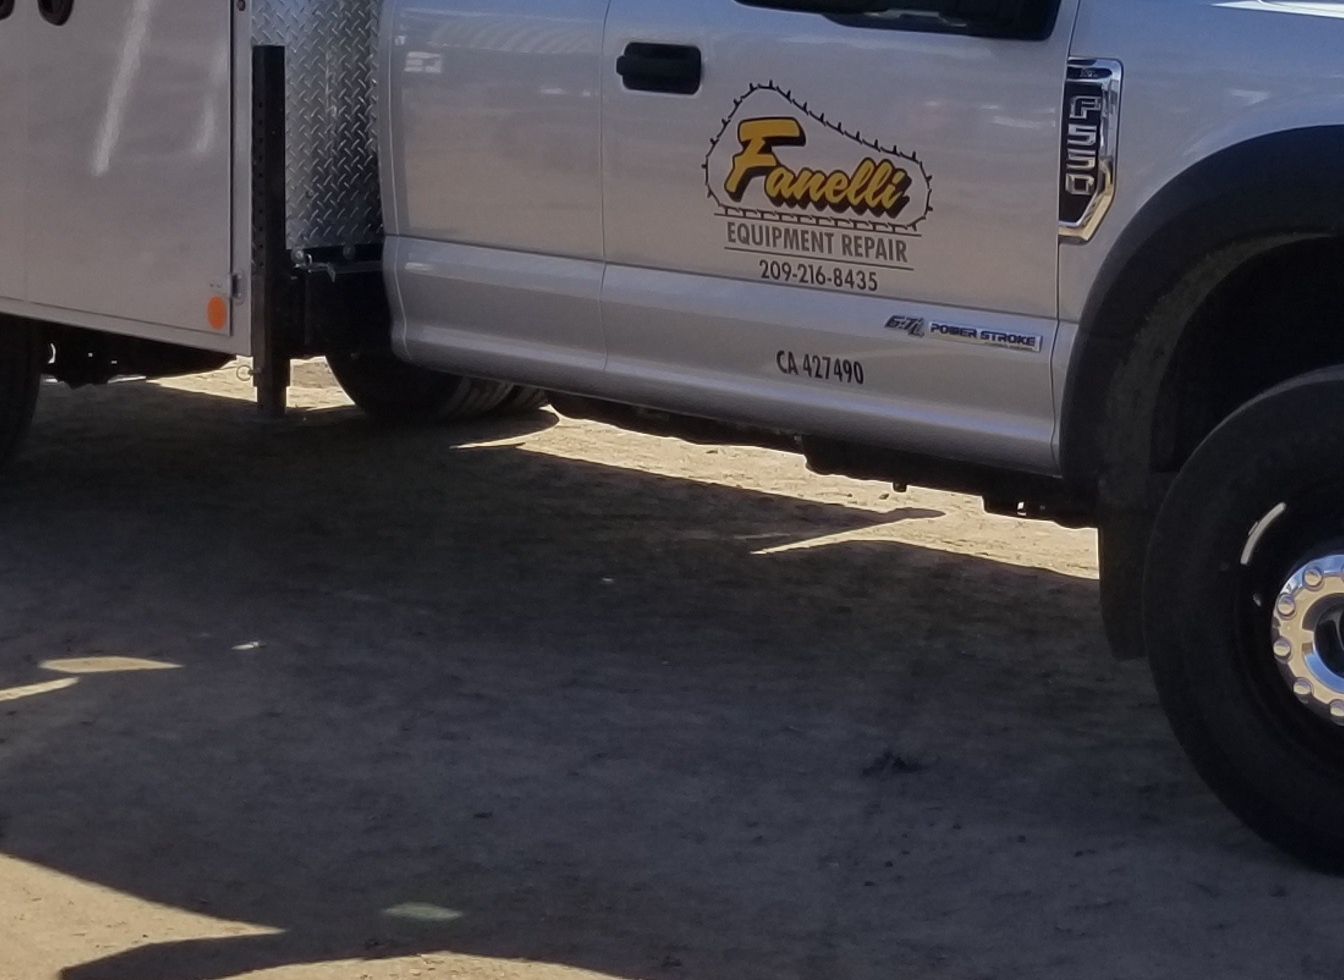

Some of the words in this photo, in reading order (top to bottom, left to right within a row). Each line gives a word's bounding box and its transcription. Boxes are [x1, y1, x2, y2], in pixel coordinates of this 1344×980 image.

[724, 117, 912, 218] Fanelli
[727, 222, 834, 255] EQUIPMENT
[841, 234, 908, 263] REPAIR
[759, 259, 878, 292] 209-216-8435
[930, 323, 977, 340] POWER
[980, 330, 1036, 347] STROKE
[776, 350, 798, 375] CA
[803, 355, 864, 385] 427490
